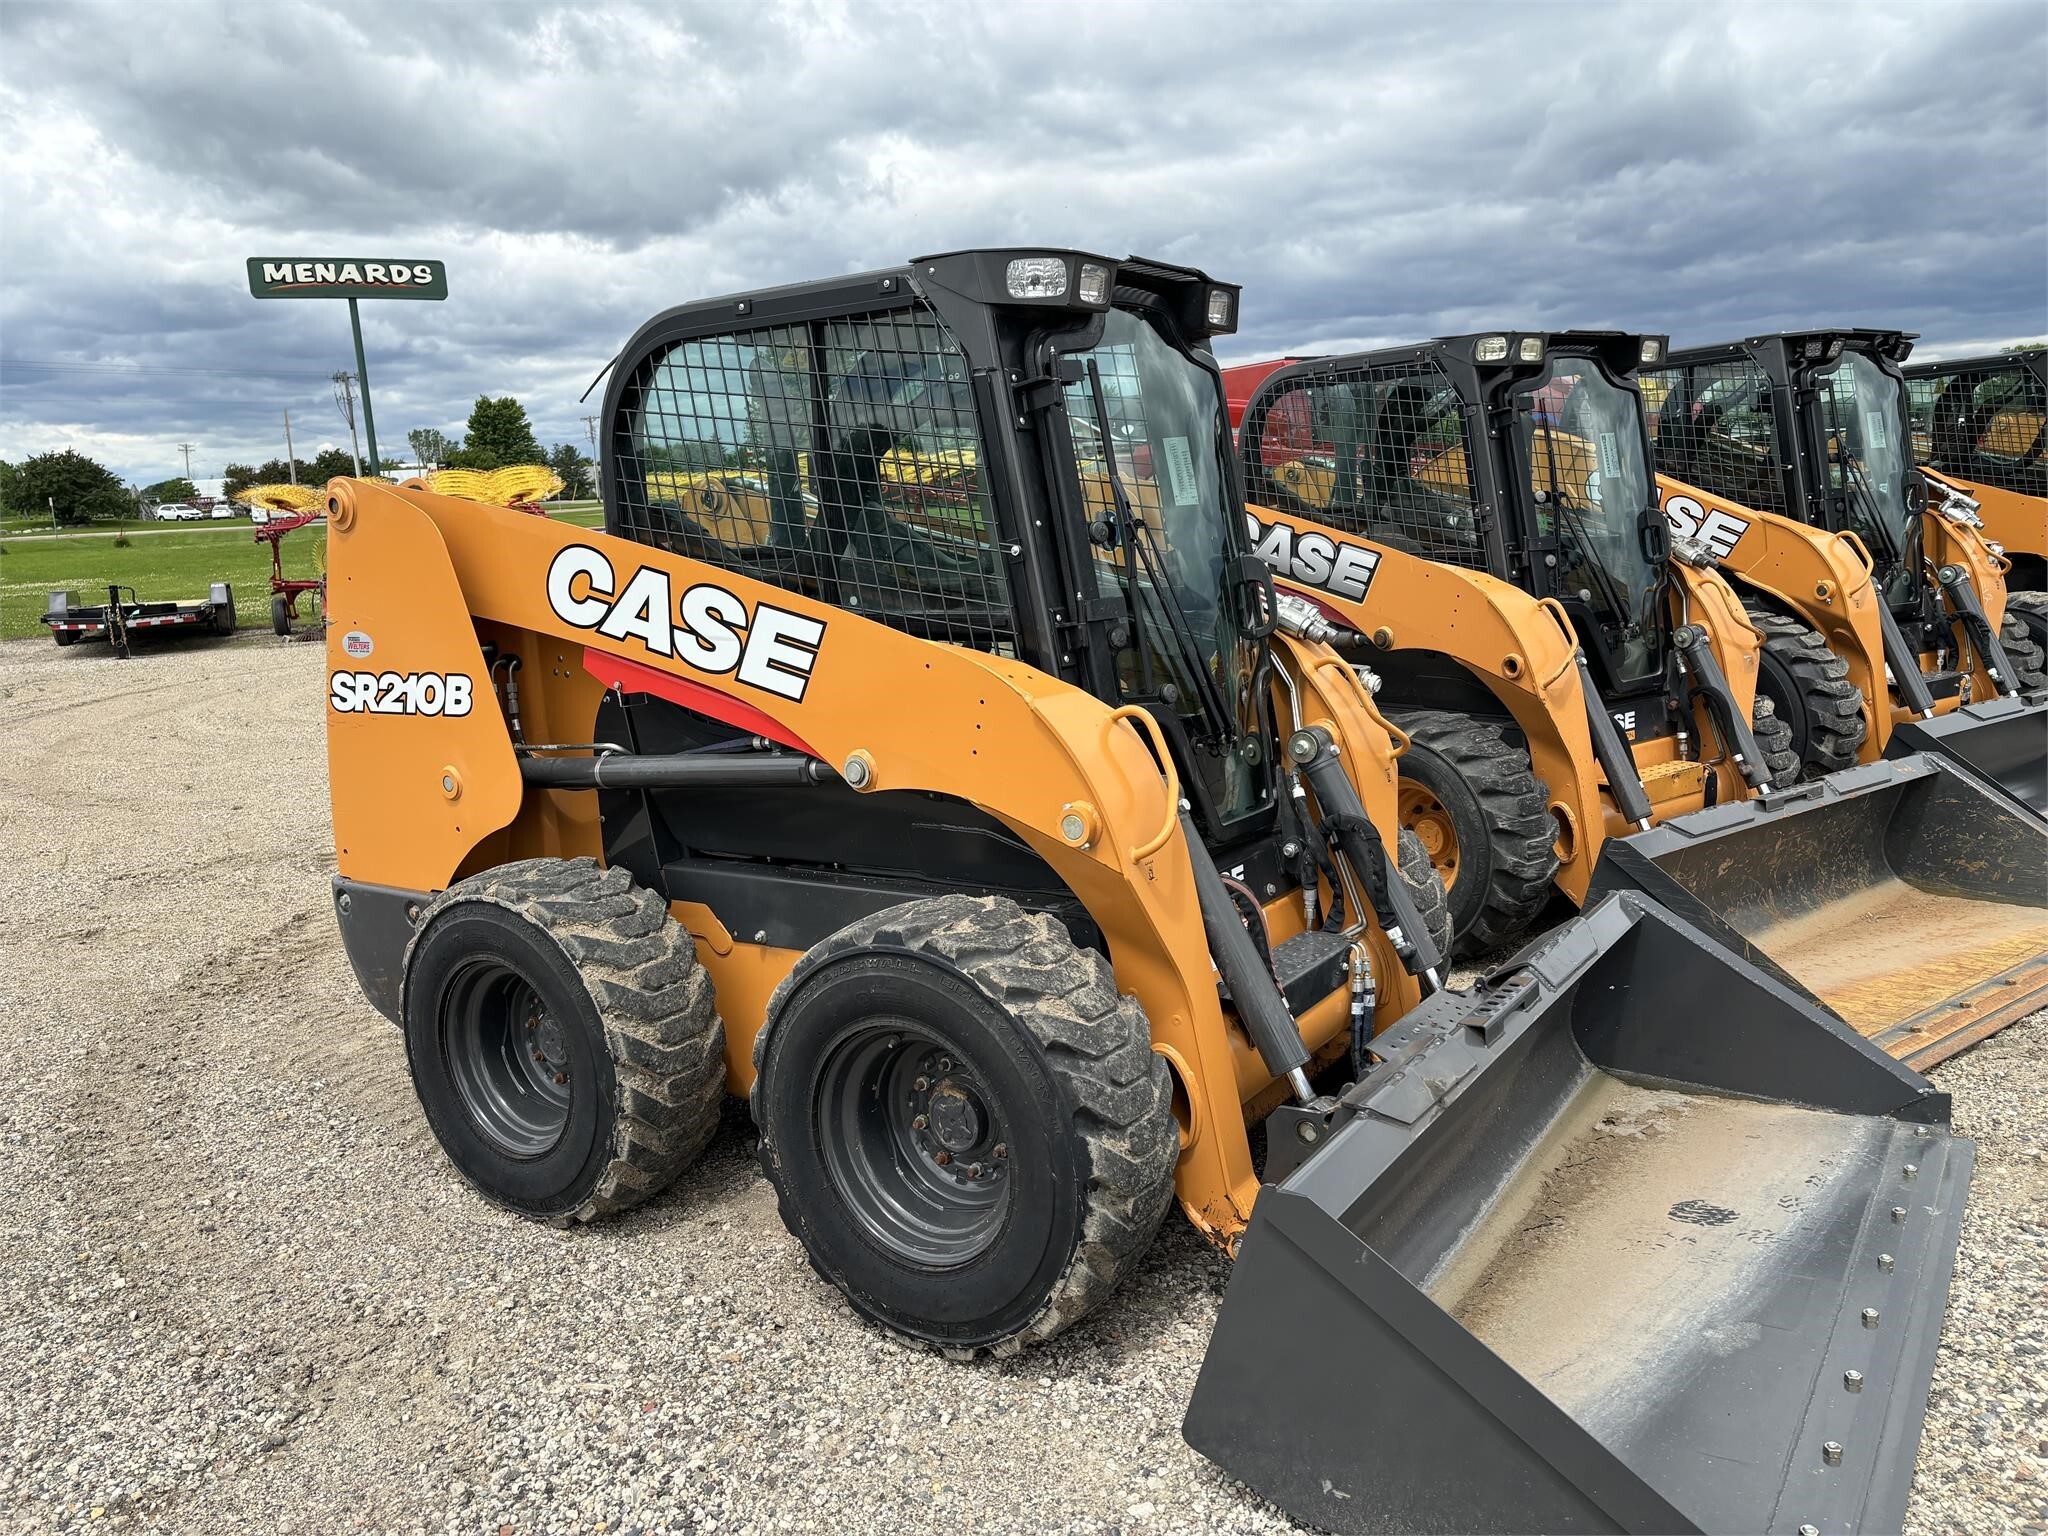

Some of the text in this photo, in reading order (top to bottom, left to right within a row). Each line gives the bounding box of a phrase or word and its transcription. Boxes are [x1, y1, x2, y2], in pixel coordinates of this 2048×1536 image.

[262, 263, 433, 285] MENARDS
[547, 543, 828, 704] CASE
[330, 670, 473, 717] SR210B
